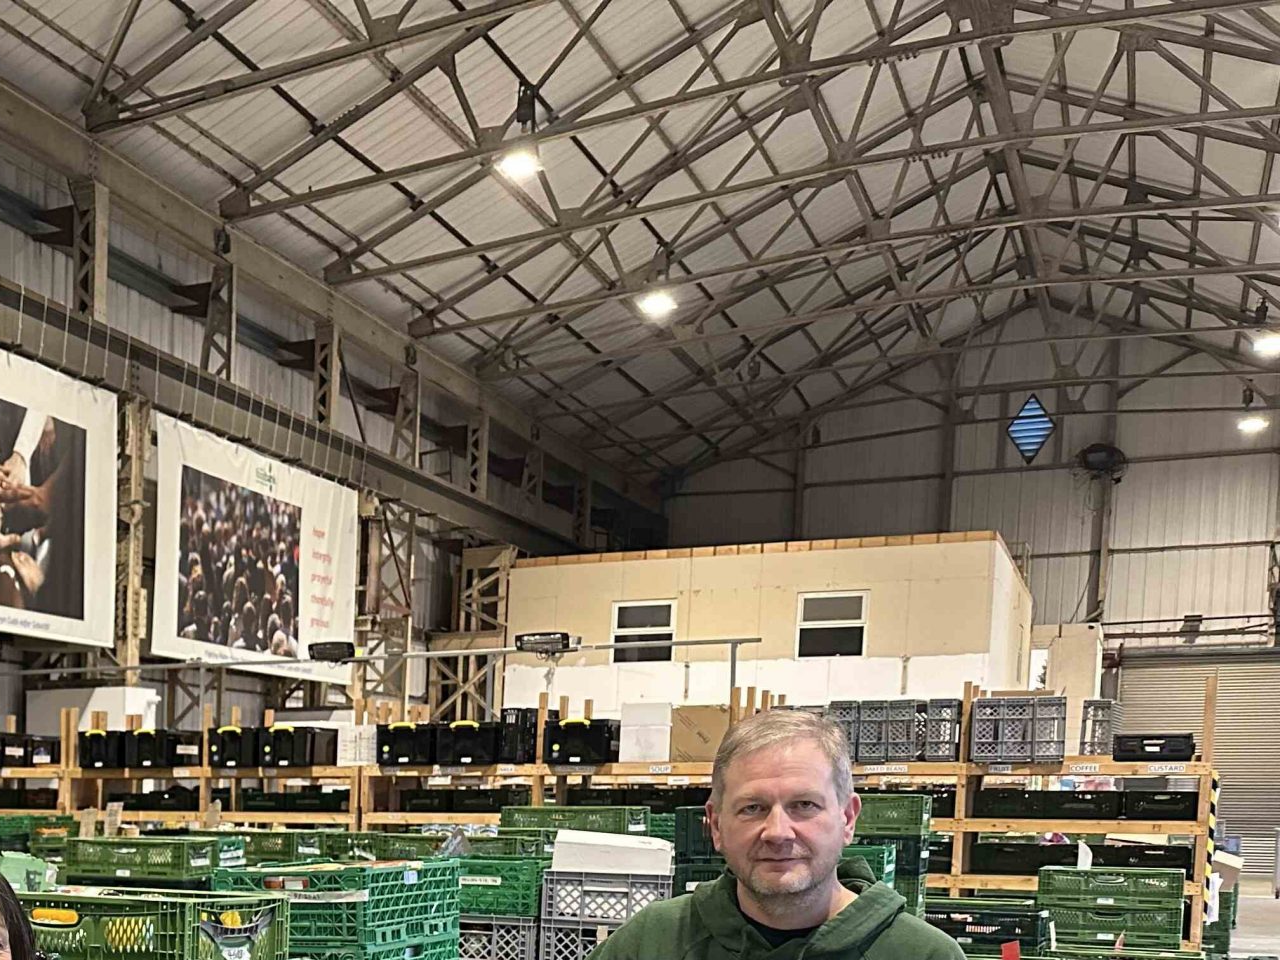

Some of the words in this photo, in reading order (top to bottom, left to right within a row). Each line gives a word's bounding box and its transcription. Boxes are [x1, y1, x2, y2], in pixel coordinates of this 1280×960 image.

[989, 764, 1010, 773] FRUIT
[1070, 765, 1098, 773] COFFEE
[1148, 765, 1185, 773] CUSTARD
